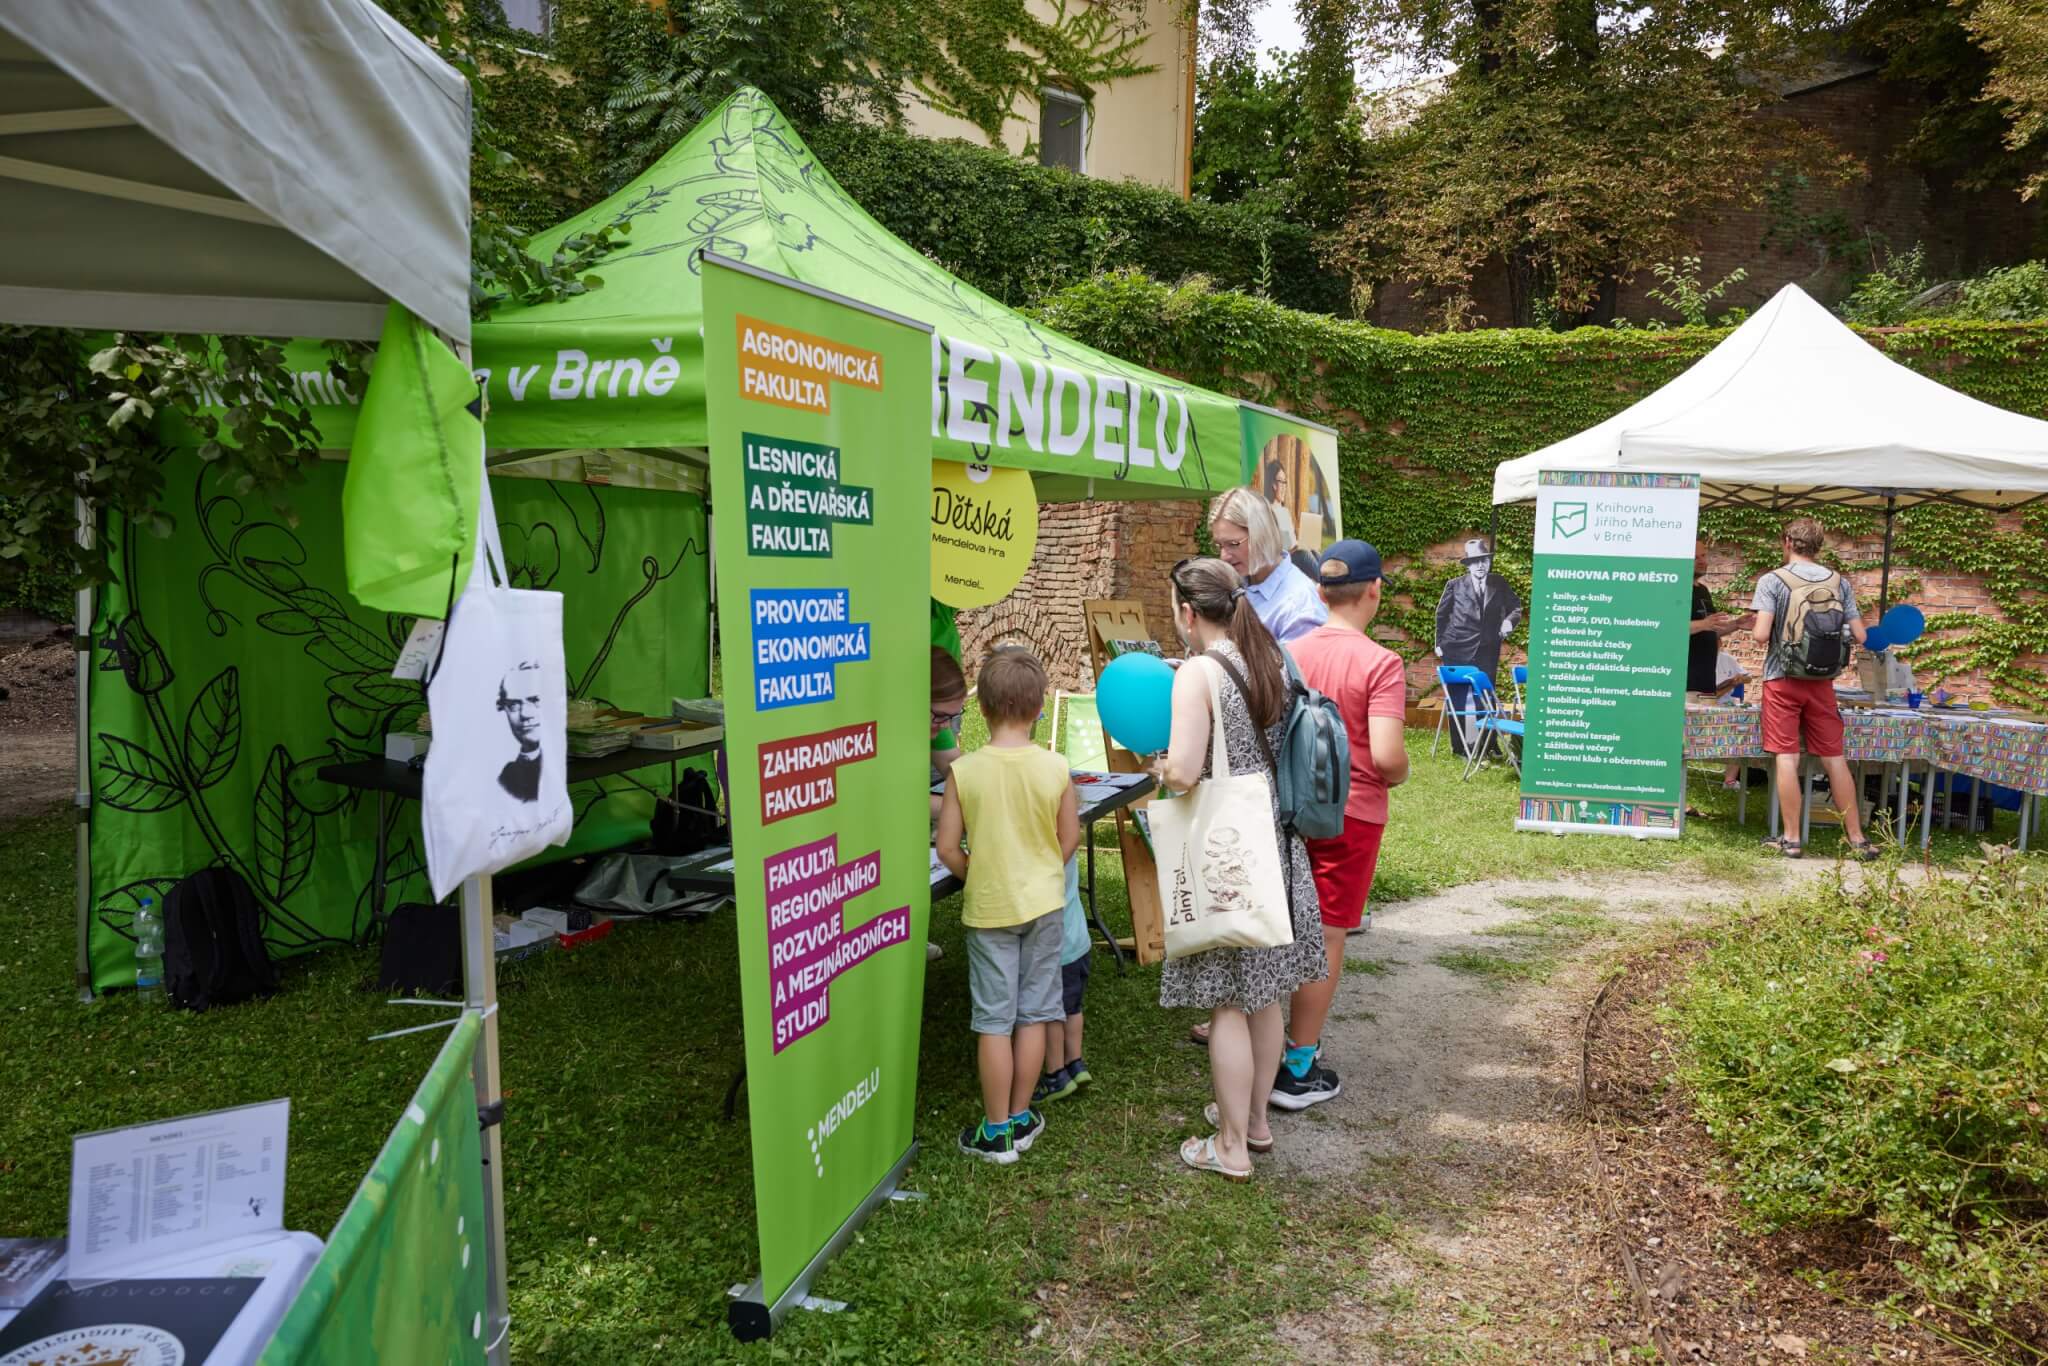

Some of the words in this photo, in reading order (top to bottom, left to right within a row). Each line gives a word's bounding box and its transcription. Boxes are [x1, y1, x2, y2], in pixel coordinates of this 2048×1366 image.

[742, 328, 879, 385] AGRONOMICKÁ
[506, 364, 541, 401] v
[549, 337, 682, 400] Brně
[744, 367, 827, 408] FAKULTA
[748, 444, 837, 481] LESNICKÁ
[750, 484, 764, 511] A
[769, 481, 870, 519] DŘEVAŘSKÁ
[1595, 502, 1654, 514] Knihovna
[931, 487, 1014, 541] Dětská
[1594, 517, 1628, 529] Jiřího
[1632, 517, 1682, 529] Mahena
[752, 524, 830, 552] FAKULTA
[932, 533, 986, 553] Mendelova
[988, 545, 1006, 558] hra
[1594, 532, 1600, 541] v
[1604, 530, 1632, 542] Brně
[1547, 568, 1609, 581] KNIHOVNA
[1612, 570, 1636, 582] PRO
[1638, 569, 1679, 583] MĚSTO
[1553, 592, 1579, 602] knihy,
[1580, 593, 1613, 603] e-knihy
[756, 592, 845, 625] PROVOZNĚ
[1552, 603, 1589, 614] časopisy
[1551, 626, 1586, 635] deskové
[1587, 628, 1602, 637] hry
[1552, 615, 1566, 624] CD,
[1568, 616, 1589, 625] MP3,
[1591, 617, 1612, 626] DVD,
[1613, 618, 1660, 629] hudebniny
[758, 627, 867, 665] EKONOMICKÁ
[1550, 638, 1602, 648] elektronické
[1604, 640, 1632, 651] čtečky
[1550, 650, 1591, 659] tematické
[1593, 651, 1624, 662] kufříky
[1548, 672, 1594, 682] vzdělávání
[1549, 660, 1578, 671] hračky
[1586, 662, 1630, 672] didaktické
[1631, 665, 1672, 675] pomůcky
[760, 671, 832, 704] FAKULTA
[1594, 686, 1630, 696] internet,
[1632, 687, 1672, 697] databáze
[1547, 695, 1579, 704] mobilní
[1581, 697, 1616, 707] aplikace
[1546, 707, 1584, 717] koncerty
[1545, 718, 1590, 729] přednášky
[1545, 730, 1588, 740] expresivní
[1590, 732, 1620, 742] terapie
[763, 726, 873, 779] ZAHRADNICKÁ
[1544, 742, 1584, 751] zážitkové
[1586, 743, 1614, 754] večery
[1544, 752, 1580, 762] knihovní
[1582, 754, 1601, 763] klub
[1609, 757, 1667, 767] občerstvením
[765, 777, 834, 817] FAKULTA
[768, 846, 836, 892] FAKULTA
[771, 861, 877, 930] REGIONÁLNÍHO
[773, 912, 841, 969] ROZVOJE
[775, 981, 785, 1008] A
[789, 915, 906, 998] MEZINÁRODNÍCH
[776, 986, 828, 1044] STUDIÍ
[818, 1066, 880, 1146] MENDELU
